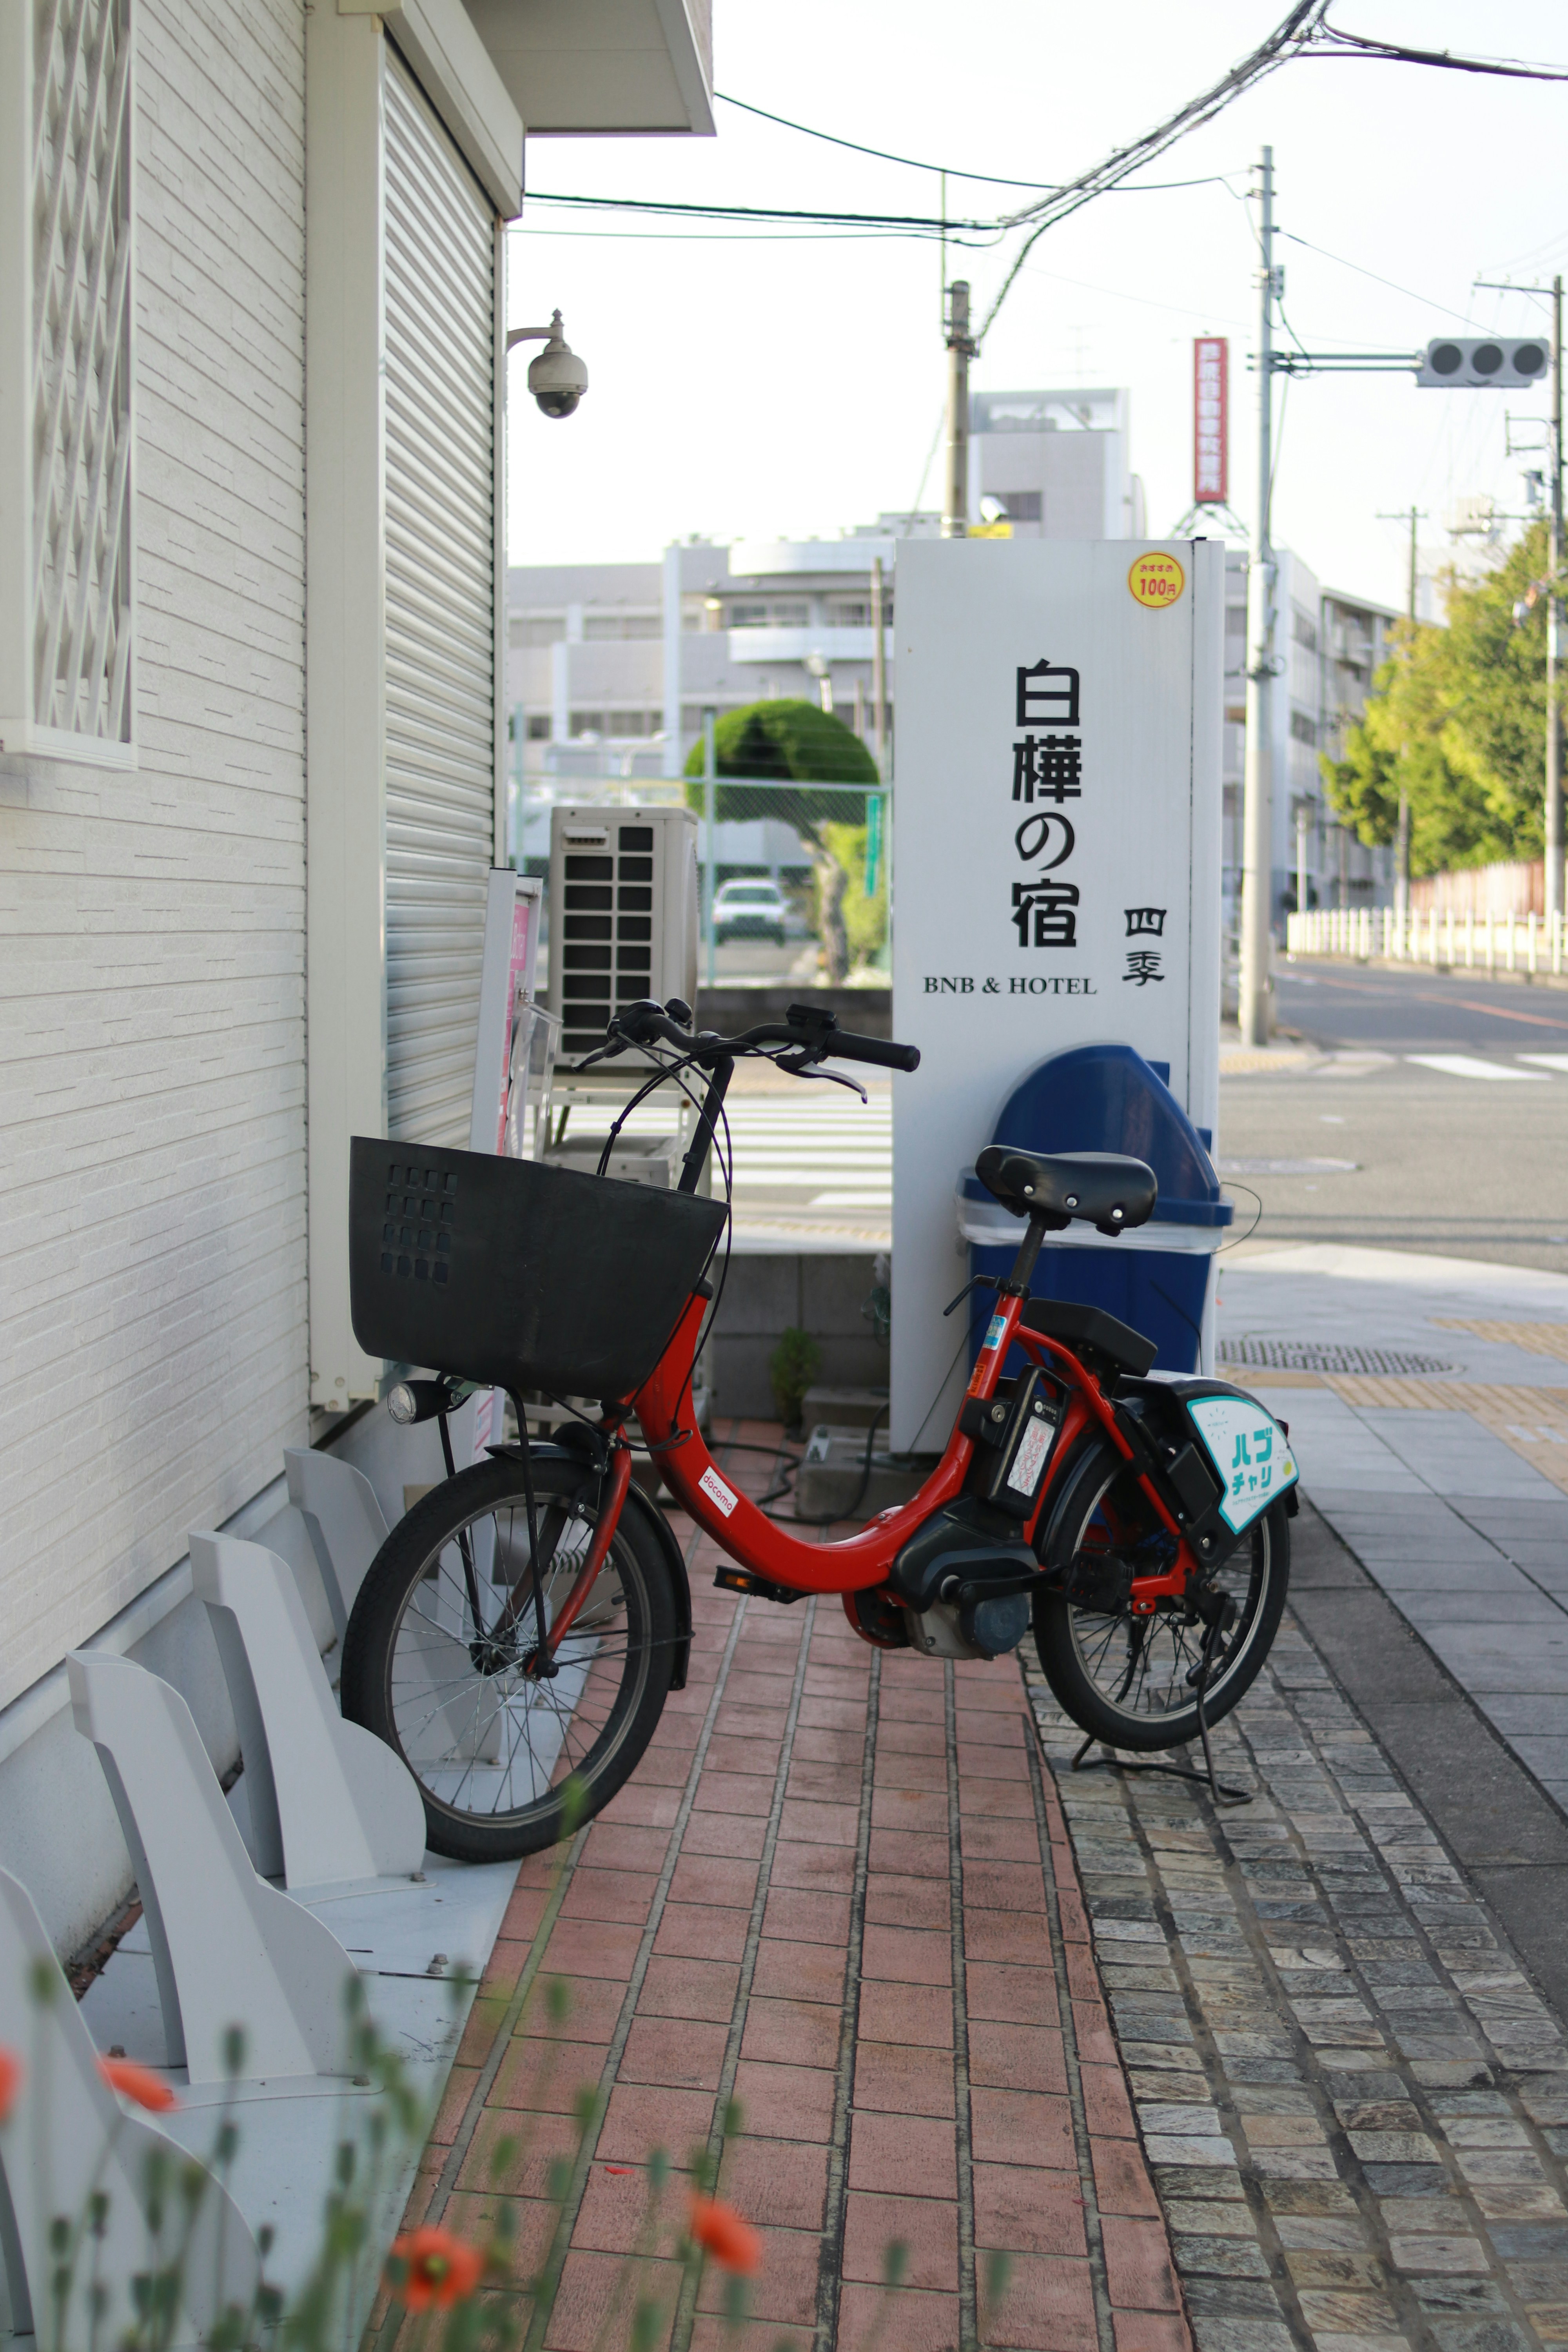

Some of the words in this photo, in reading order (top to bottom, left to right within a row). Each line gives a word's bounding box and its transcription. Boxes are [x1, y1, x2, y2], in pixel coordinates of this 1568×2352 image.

[1140, 564, 1174, 573] おすすめ
[1011, 659, 1082, 948] 白樺の宿
[1122, 907, 1167, 986] 四季
[922, 977, 974, 995] BNB
[981, 978, 1001, 995] &
[1008, 978, 1098, 995] HOTEL
[703, 1475, 733, 1510] docomo
[1232, 1466, 1272, 1496] チャリ
